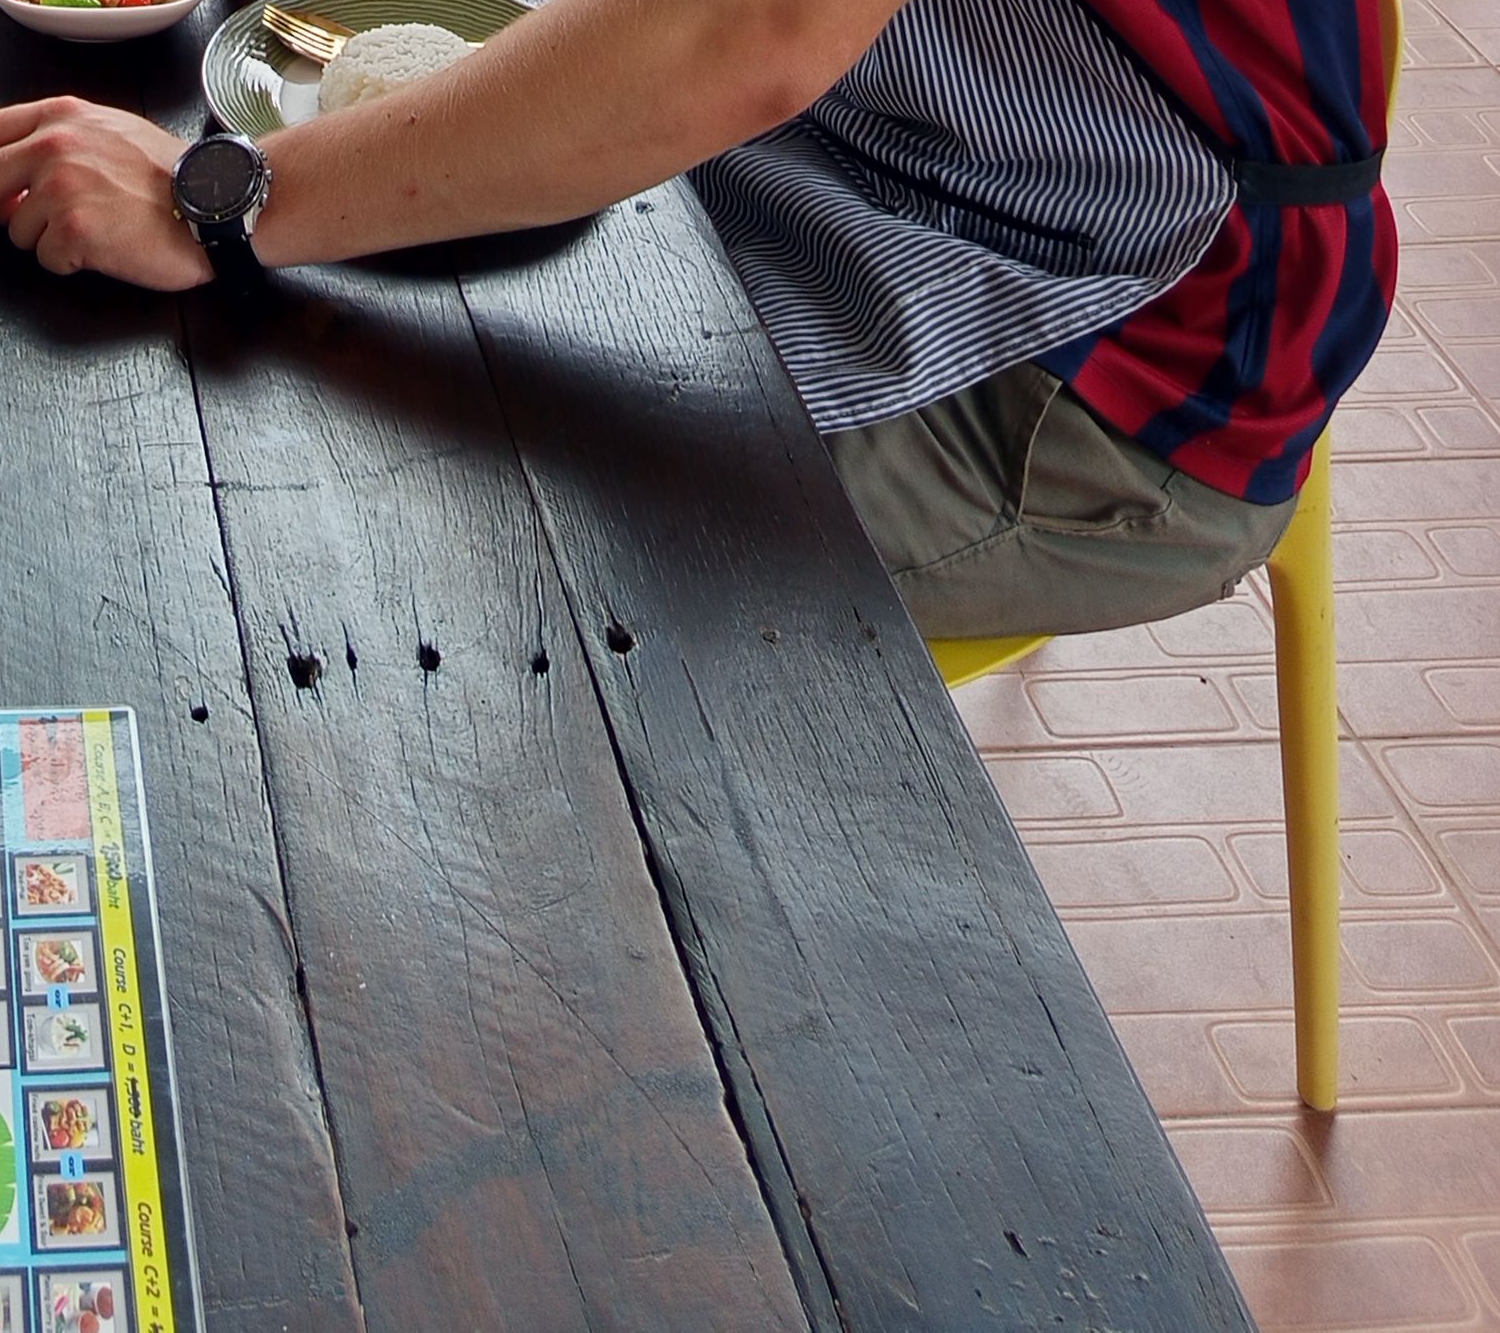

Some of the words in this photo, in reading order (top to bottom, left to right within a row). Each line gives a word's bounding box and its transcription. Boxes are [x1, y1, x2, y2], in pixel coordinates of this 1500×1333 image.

[106, 879, 120, 909] baht
[112, 947, 128, 993] Course
[121, 1043, 136, 1055] D
[129, 1119, 145, 1155] baht
[137, 1201, 155, 1257] Course
[143, 1264, 161, 1297] C+2
